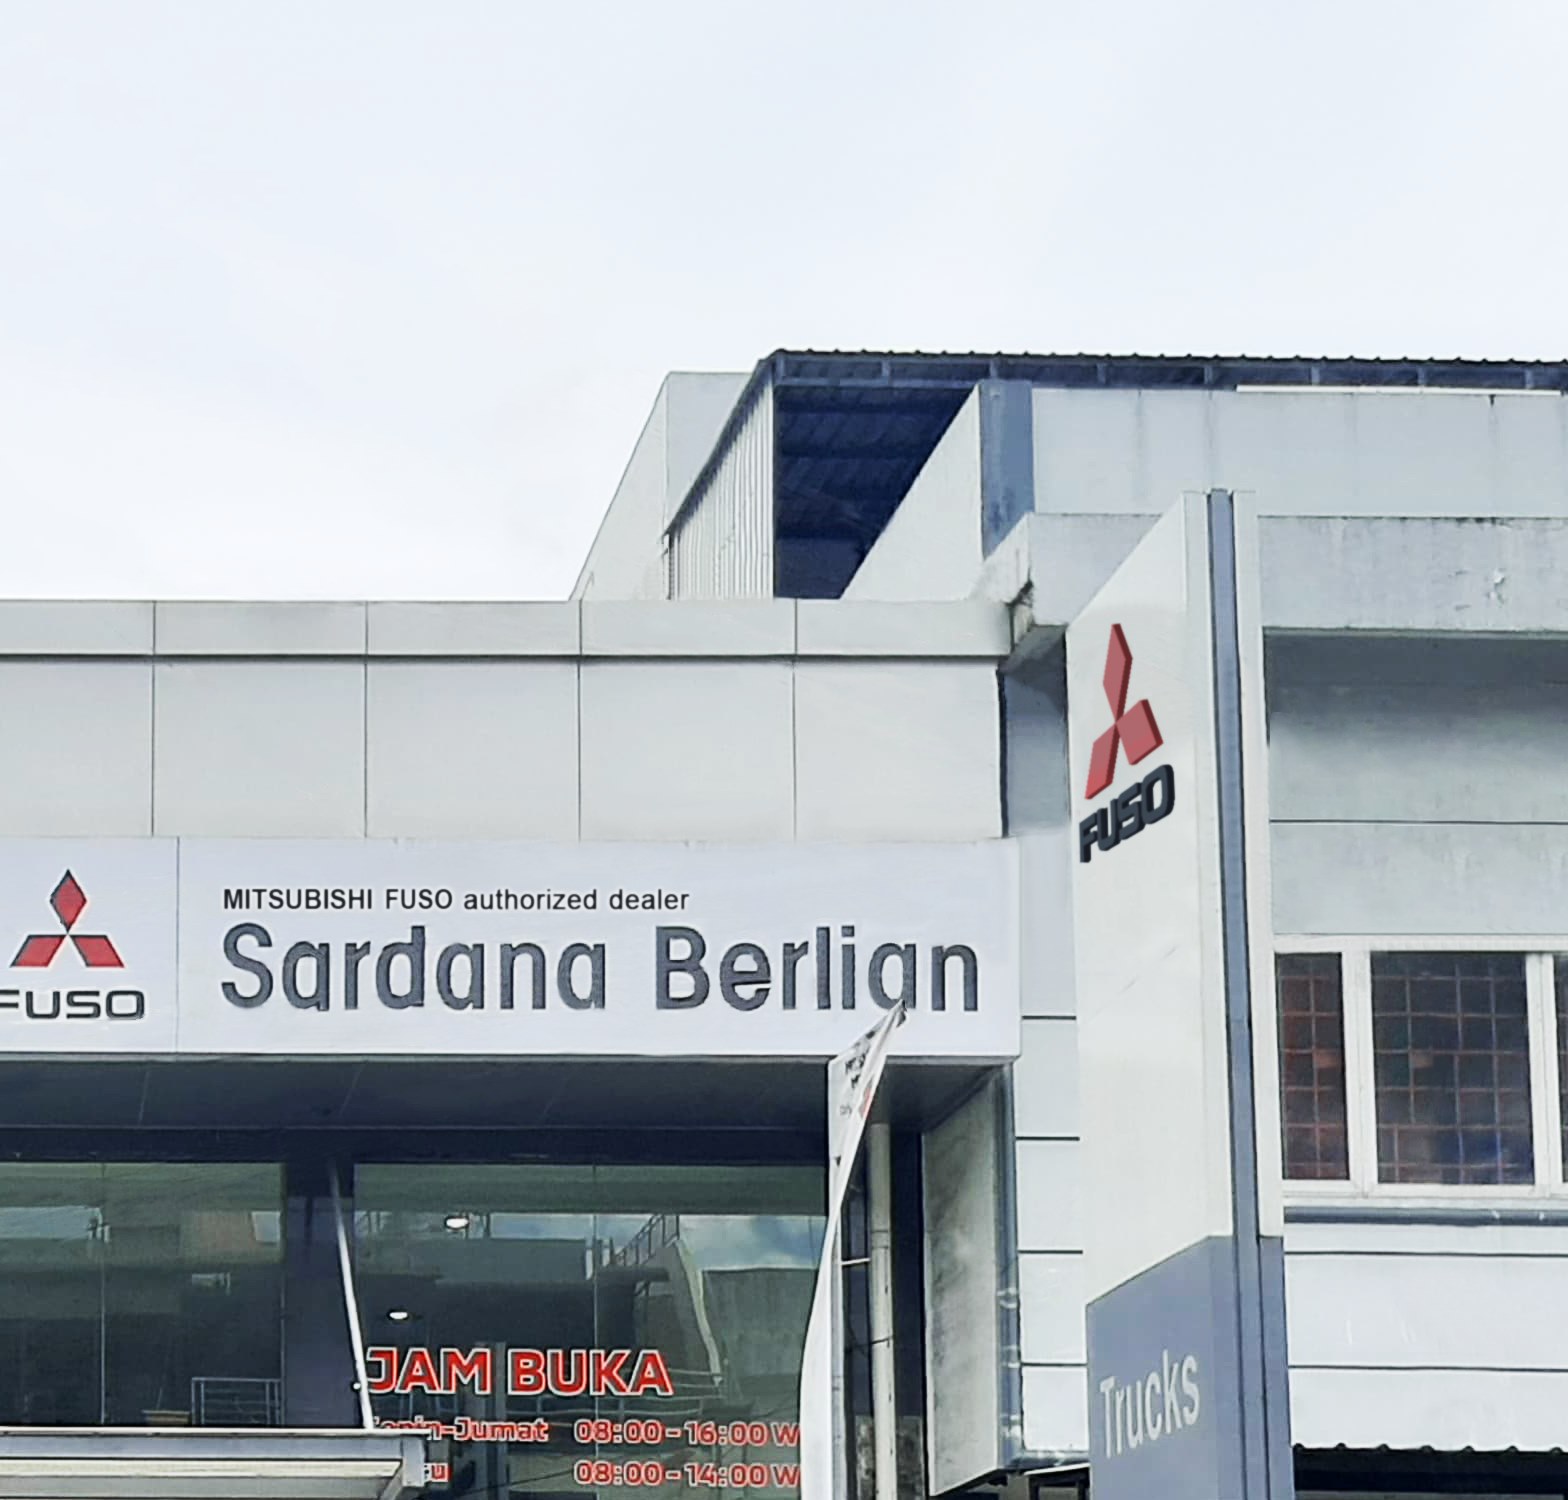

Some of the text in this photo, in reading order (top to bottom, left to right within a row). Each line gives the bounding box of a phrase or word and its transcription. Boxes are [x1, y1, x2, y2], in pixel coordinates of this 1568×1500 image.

[1079, 764, 1175, 863] FUSO
[223, 888, 689, 911] MITSUBISHI FUSO authorized dealer
[221, 922, 978, 1012] Sardana Berlian
[366, 1347, 673, 1396] JAM BUKA
[1100, 1349, 1200, 1459] Trucks
